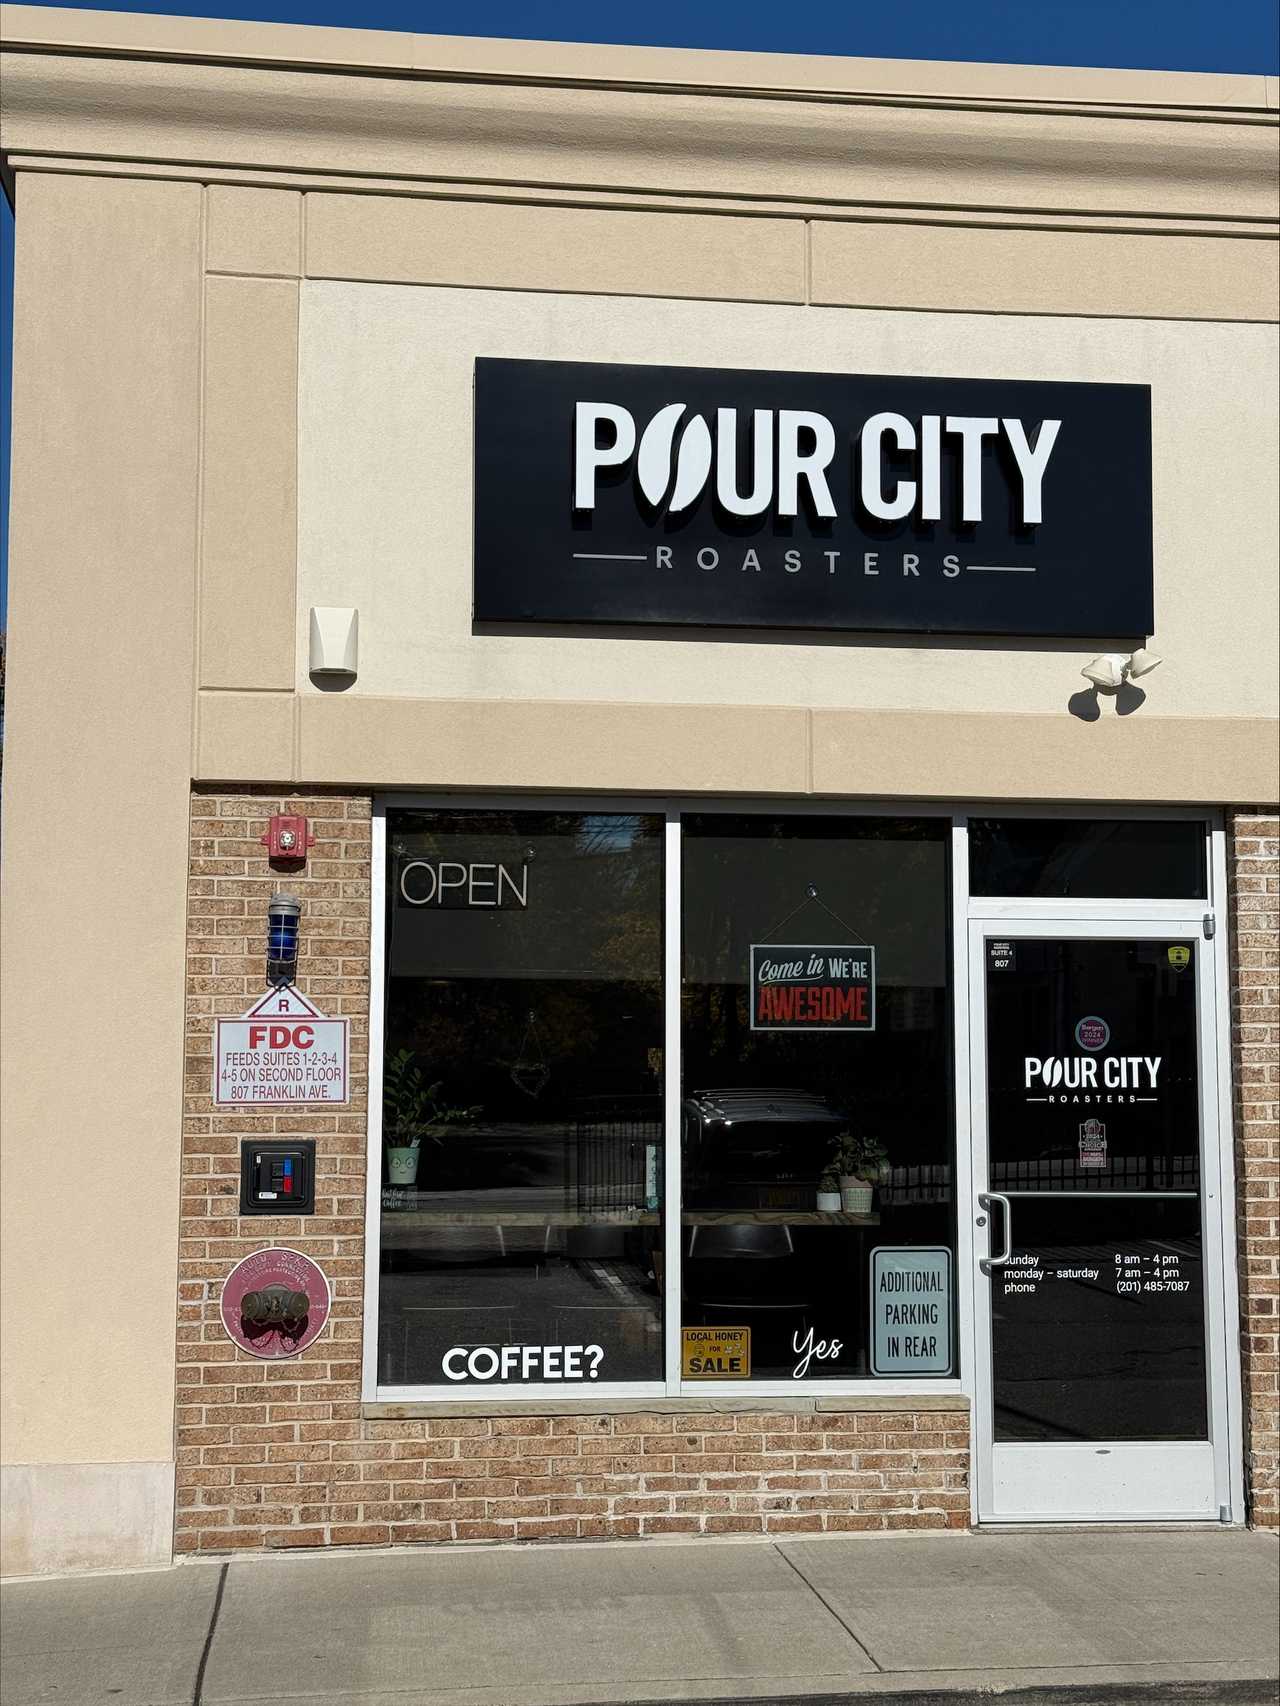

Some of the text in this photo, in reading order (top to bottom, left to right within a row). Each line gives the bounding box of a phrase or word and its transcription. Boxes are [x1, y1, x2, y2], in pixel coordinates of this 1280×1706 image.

[575, 401, 1062, 525] POUR CITY
[657, 546, 961, 578] ROASTERS
[400, 861, 528, 907] OPEN
[758, 953, 868, 982] Come in WE'RE
[994, 959, 1009, 968] 807
[278, 999, 290, 1012] R
[758, 986, 869, 1023] AWESOME
[249, 1025, 315, 1050] FDC
[226, 1052, 337, 1066] FEEDS SUITES 1-2-3-4
[221, 1067, 341, 1082] 4-5 ON SECOND FLOOR
[1025, 1056, 1162, 1089] POUR CITY
[231, 1085, 331, 1099] 807 FRANKLIN AVE.
[1049, 1095, 1136, 1103] ROASTERS
[1115, 1254, 1121, 1264] 8
[1124, 1256, 1141, 1264] am
[1152, 1254, 1160, 1264] 4
[1162, 1256, 1179, 1267] pm
[880, 1271, 944, 1292] ADDITIONAL
[1004, 1268, 1044, 1280] monday
[1056, 1268, 1099, 1280] saturday
[1115, 1268, 1122, 1278] 7
[1125, 1270, 1141, 1278] am
[1153, 1268, 1161, 1278] 4
[1163, 1270, 1180, 1280] pm
[1004, 1282, 1036, 1294] phone
[1116, 1281, 1190, 1294] (201) 485-7087
[885, 1303, 938, 1325] PARKING
[687, 1331, 744, 1341] LOCAL HONEY
[792, 1327, 844, 1379] Yes
[888, 1336, 937, 1358] IN REAR
[441, 1344, 605, 1381] COFFEE?
[689, 1357, 742, 1373] SALE
